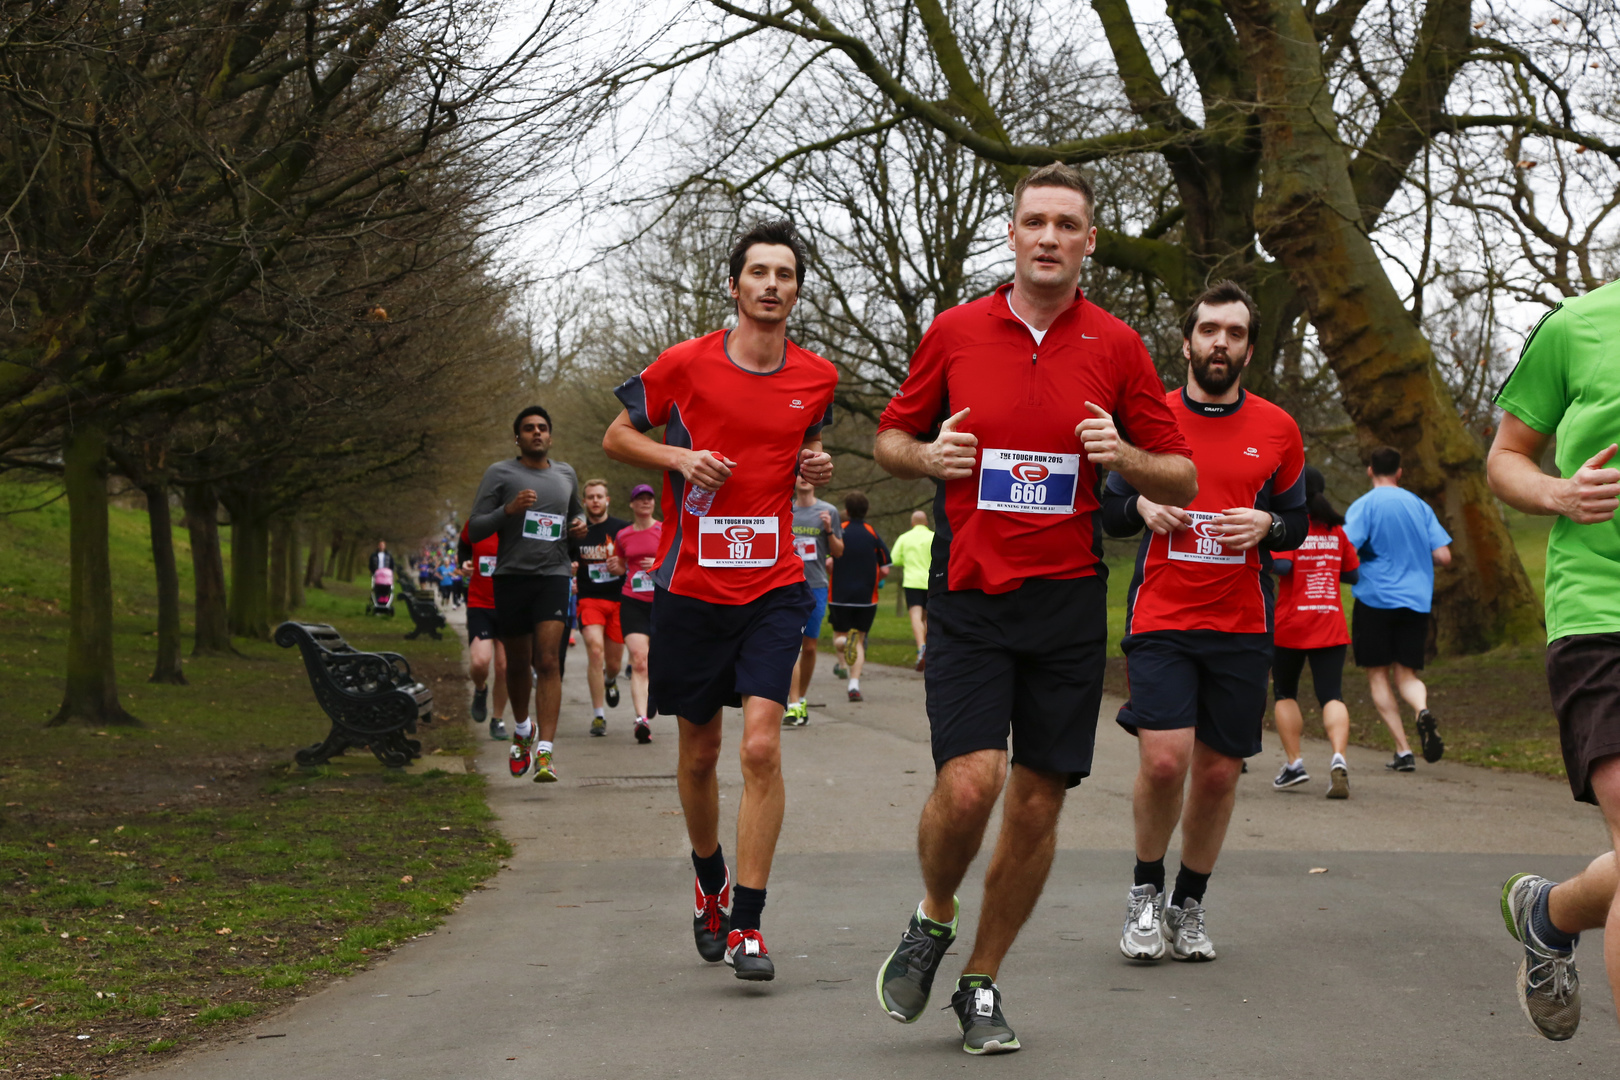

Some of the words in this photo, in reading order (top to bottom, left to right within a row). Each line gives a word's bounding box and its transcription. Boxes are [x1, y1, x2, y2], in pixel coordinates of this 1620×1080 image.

[1012, 453, 1033, 461] TOUGH
[1048, 456, 1063, 464] 2015
[1010, 482, 1047, 504] 660
[1196, 513, 1213, 521] TOUGH
[792, 526, 820, 535] NISHER
[579, 546, 607, 554] TOUGH
[727, 542, 753, 559] 197
[1195, 537, 1223, 556] 196
